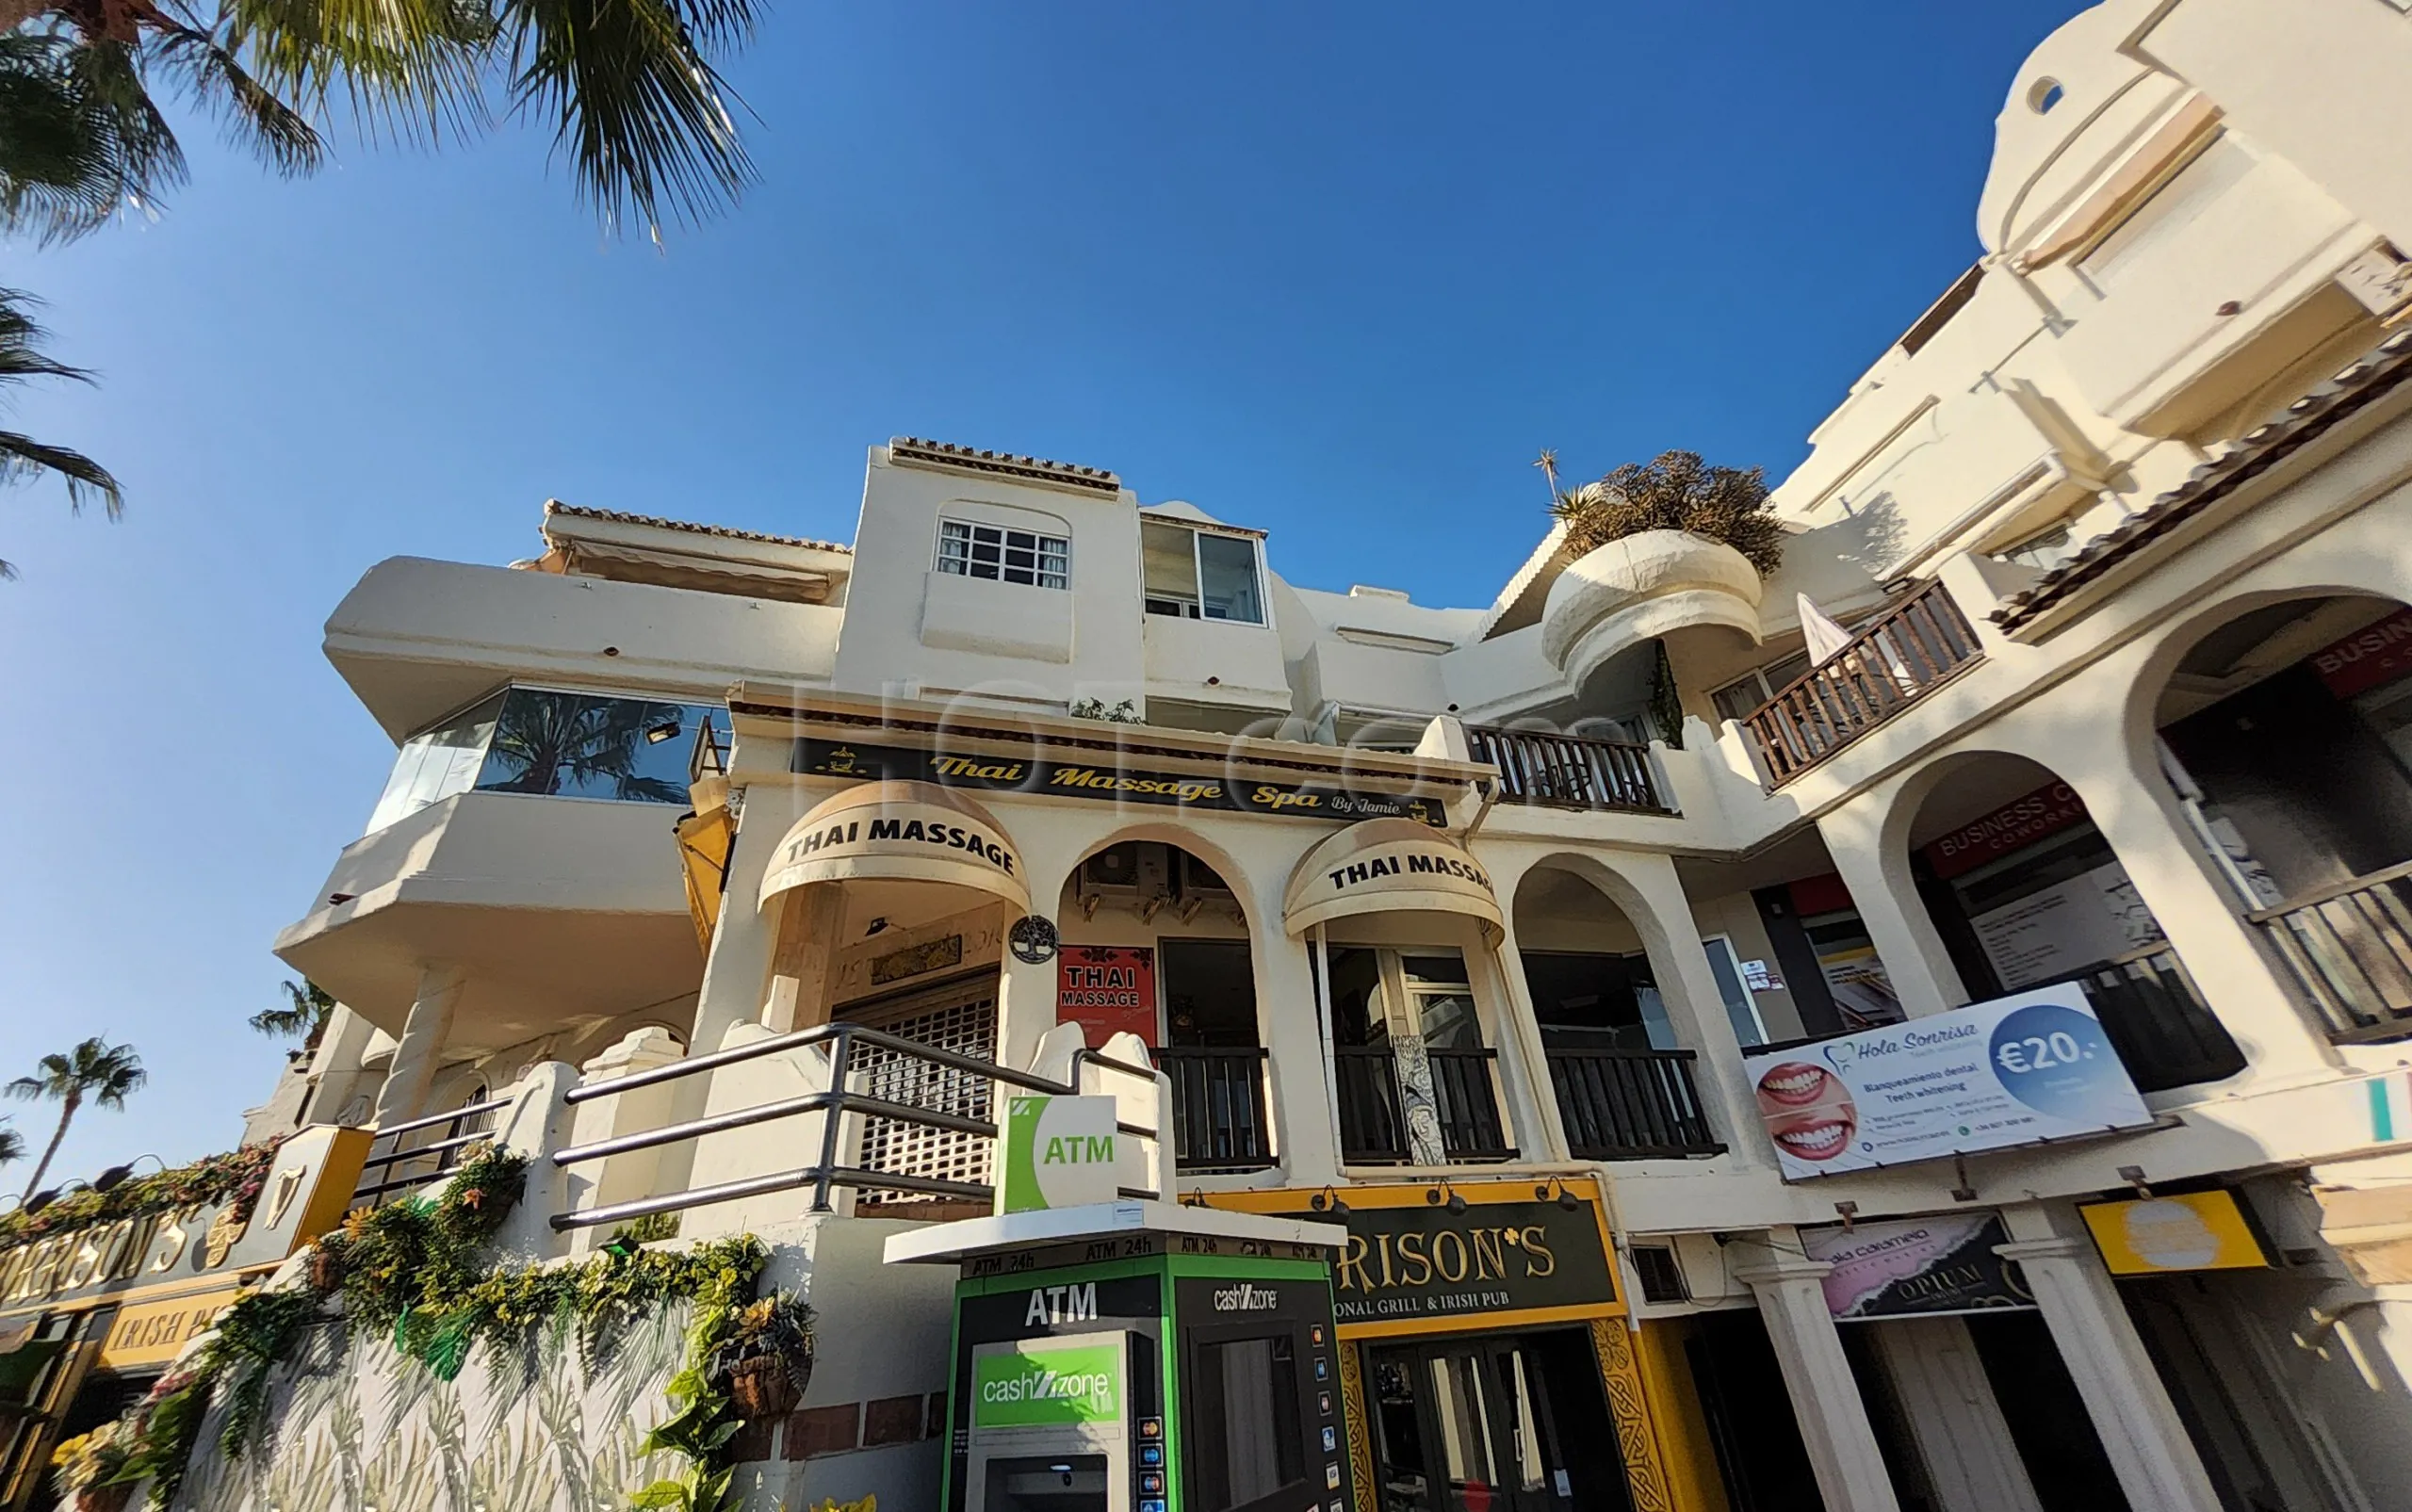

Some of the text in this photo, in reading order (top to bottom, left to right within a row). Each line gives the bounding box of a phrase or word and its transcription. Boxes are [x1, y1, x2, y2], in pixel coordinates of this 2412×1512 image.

[929, 755, 1402, 815] Thai Massage Spa By Jamie
[1938, 797, 2047, 856] BUSINESS
[787, 819, 1016, 877] THAI MASSAGE
[1328, 855, 1401, 890] THAI
[1064, 965, 1135, 989] THAI
[1060, 991, 1140, 1007] MASSAGE
[1858, 1040, 1900, 1060] Hola
[1902, 1024, 1979, 1049] Sonrisa
[1864, 1063, 1980, 1094] Blanqueamiento dental
[1885, 1081, 1967, 1105] Teeth whitening
[1043, 1135, 1115, 1165] ATM
[1085, 1240, 1152, 1260] ATM 24h
[1181, 1236, 1199, 1253] ATM
[972, 1257, 1002, 1275] ATM
[1897, 1263, 1984, 1300] OPIUM
[1025, 1282, 1099, 1327] ATM
[1377, 1297, 1421, 1314] GRILL
[1426, 1296, 1438, 1310] &
[1440, 1293, 1479, 1309] IRISH
[1482, 1291, 1509, 1307] PUB
[109, 1310, 187, 1351] IRISH
